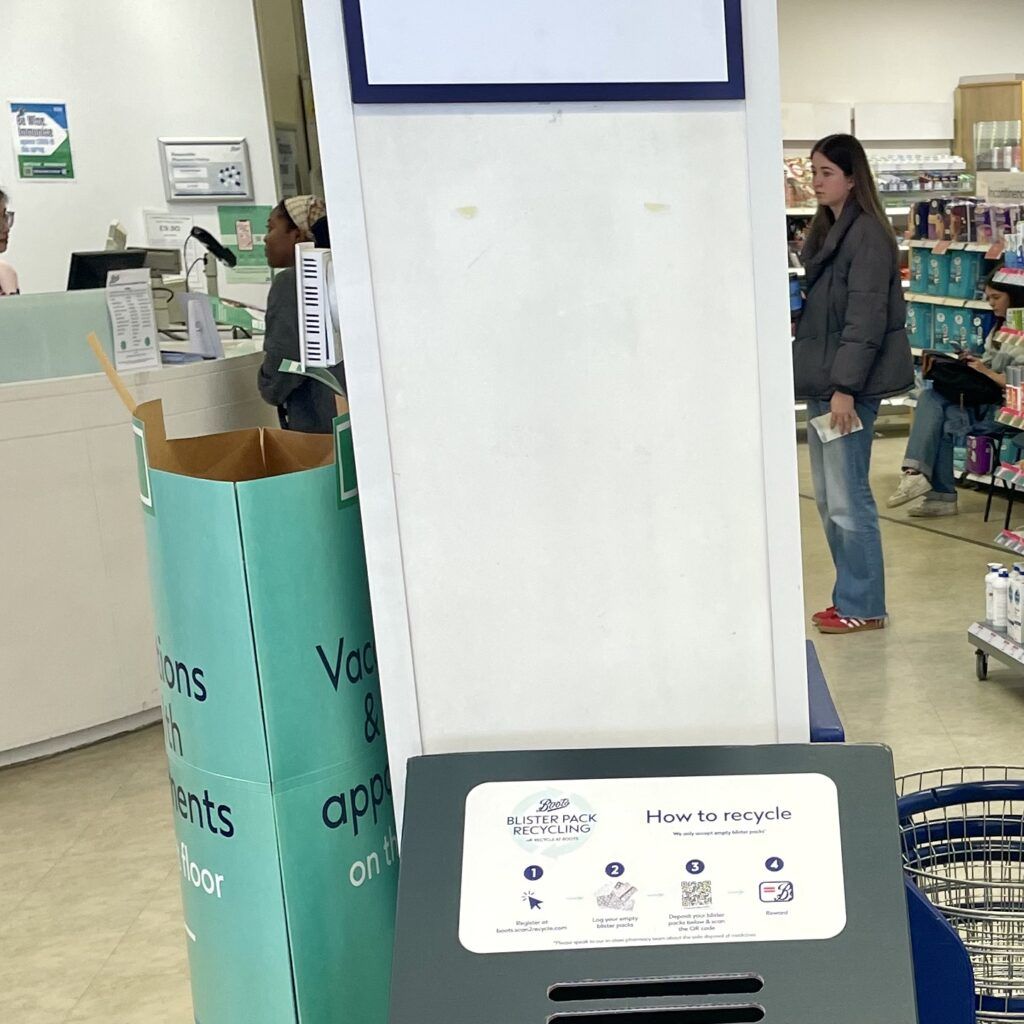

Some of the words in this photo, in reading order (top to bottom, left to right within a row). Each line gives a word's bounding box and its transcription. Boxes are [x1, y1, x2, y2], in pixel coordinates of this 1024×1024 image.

[316, 637, 378, 691] Vac
[364, 692, 380, 743] &
[536, 798, 570, 812] Boots
[647, 810, 692, 823] How
[698, 810, 717, 822] to
[724, 806, 792, 824] recycle
[507, 815, 559, 825] BLISTER
[562, 814, 597, 823] PACK
[513, 824, 591, 835] RECYCLING
[181, 842, 224, 898] floor
[350, 852, 380, 886] on
